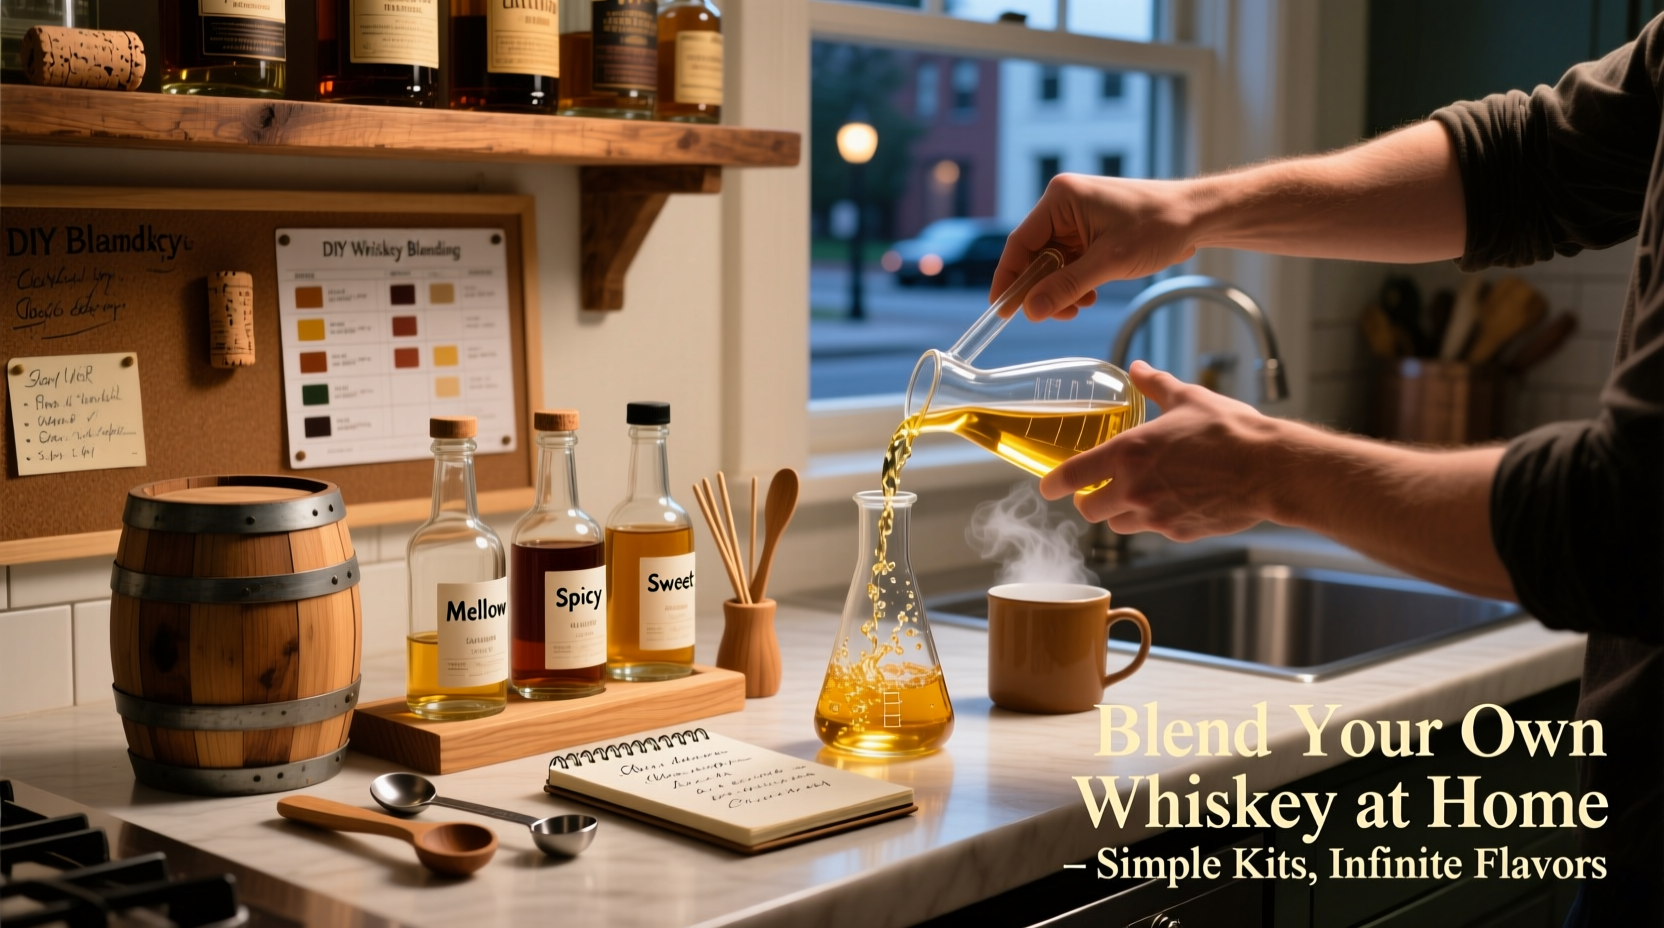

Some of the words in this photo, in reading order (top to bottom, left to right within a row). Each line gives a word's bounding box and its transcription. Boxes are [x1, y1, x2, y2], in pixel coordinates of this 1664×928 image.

[6, 226, 57, 257] DIY
[322, 240, 347, 258] DIY
[647, 570, 696, 593] Sweet
[446, 598, 507, 622] Mellow
[555, 586, 603, 612] Spicy
